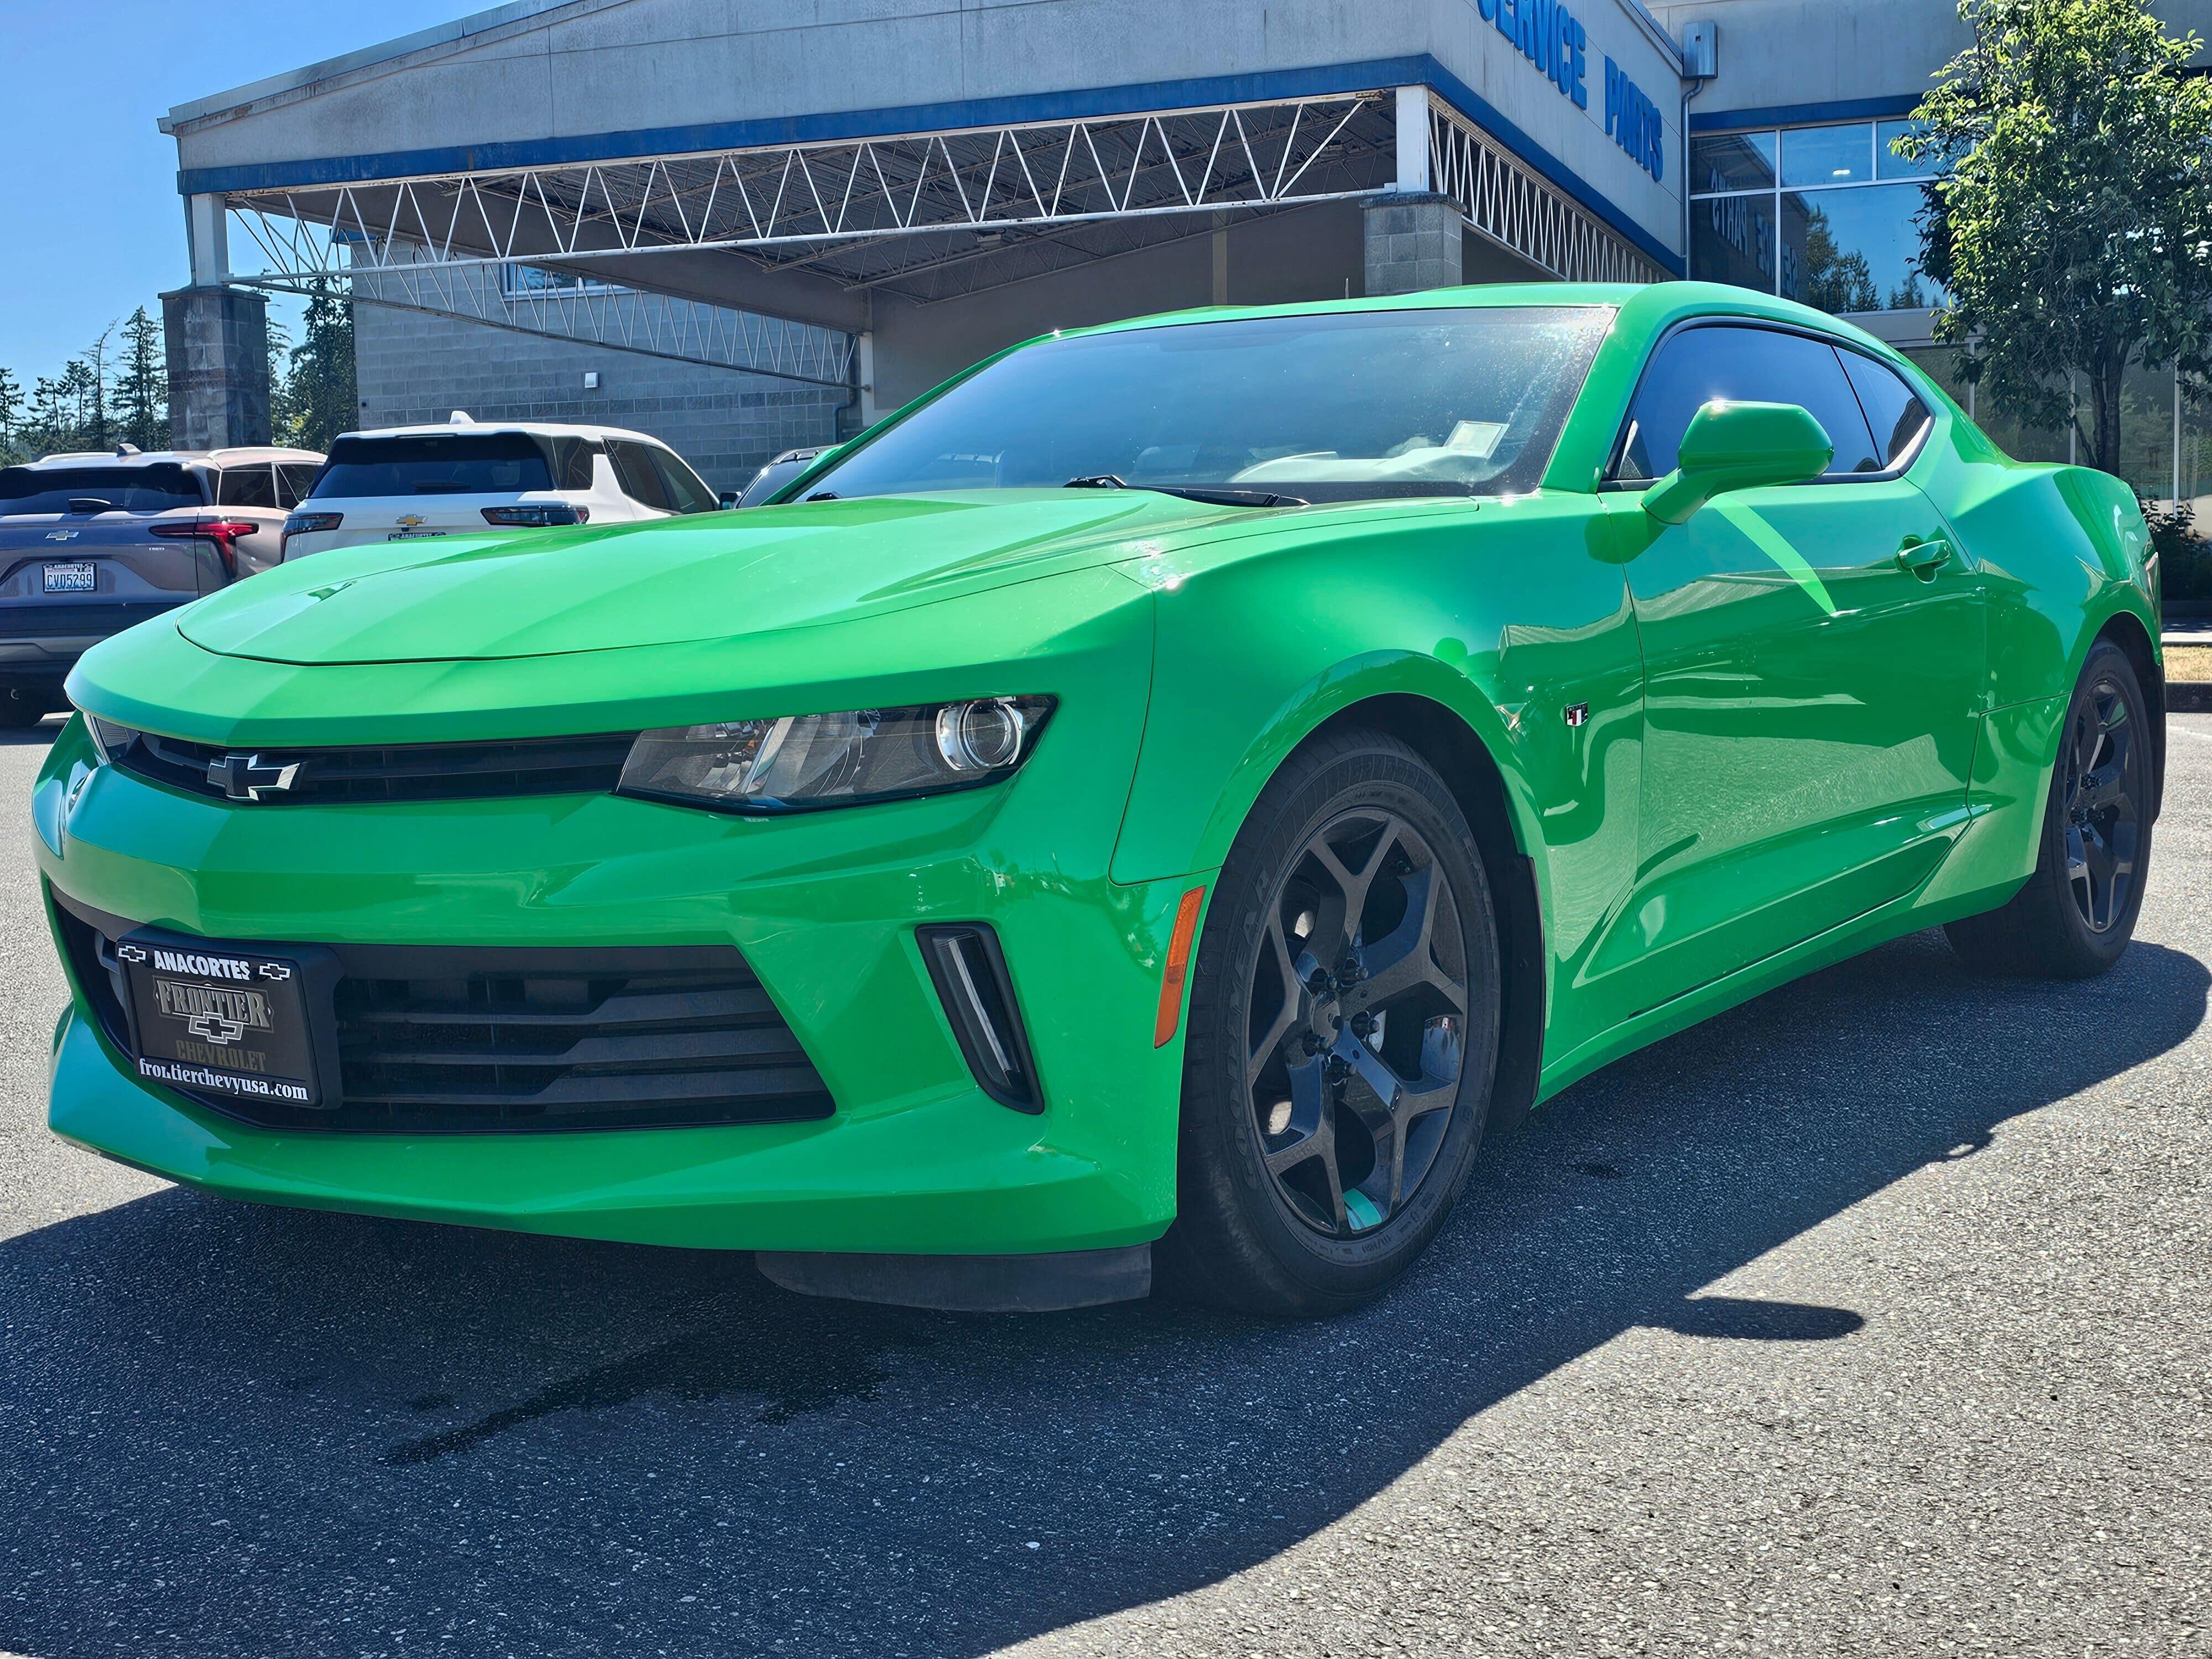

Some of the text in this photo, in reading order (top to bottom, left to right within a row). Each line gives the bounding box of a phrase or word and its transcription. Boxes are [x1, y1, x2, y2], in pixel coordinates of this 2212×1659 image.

[1477, 0, 1663, 182] RVICE PARTS
[154, 950, 251, 980] ANACORTES
[157, 980, 270, 1027] FRONTIER
[176, 1040, 266, 1072] CHEVROLET
